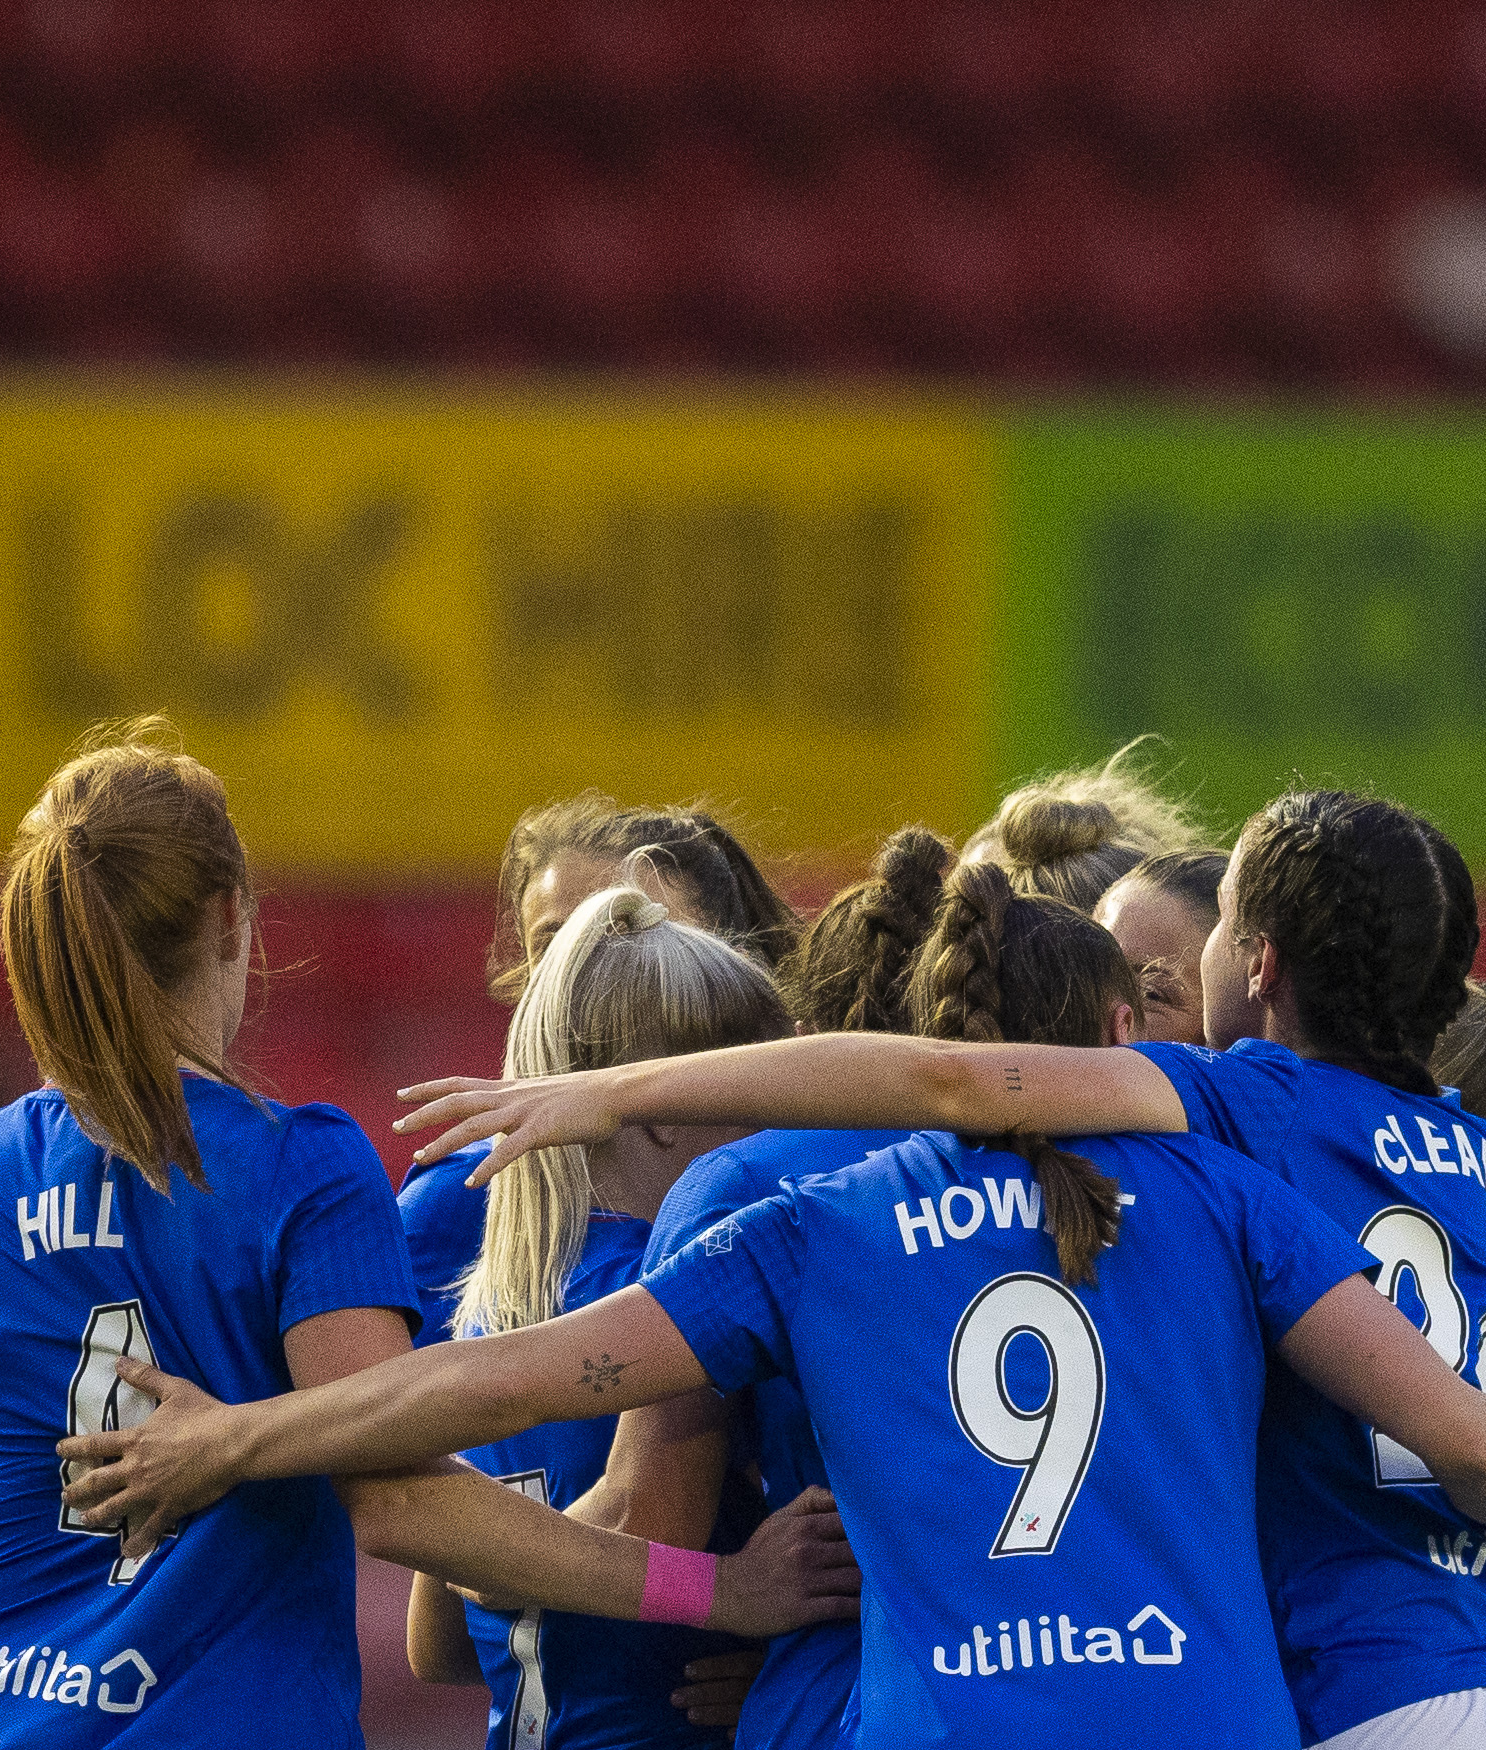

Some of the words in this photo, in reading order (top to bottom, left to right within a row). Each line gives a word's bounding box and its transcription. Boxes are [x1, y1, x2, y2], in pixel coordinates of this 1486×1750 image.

[17, 1181, 123, 1261] HILL
[894, 1177, 1136, 1255] HOW
[948, 1270, 1106, 1559] 9
[933, 1613, 1125, 1676] utilita
